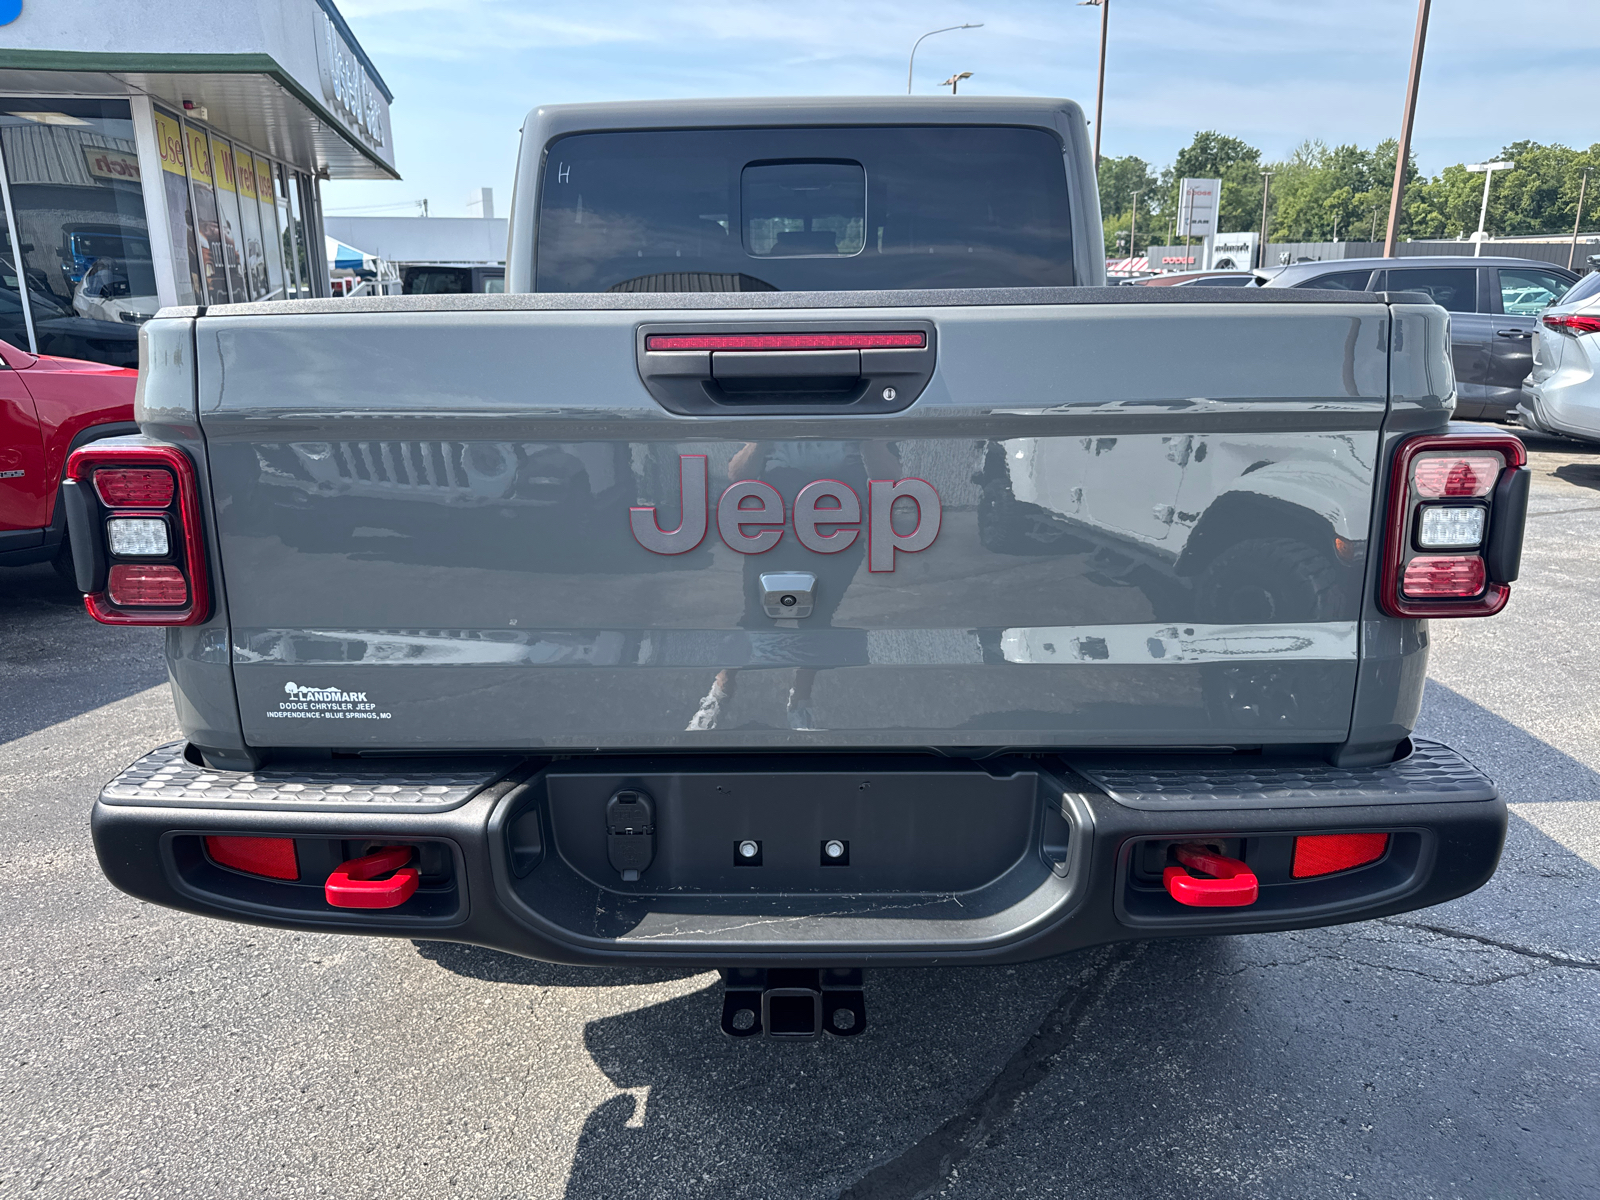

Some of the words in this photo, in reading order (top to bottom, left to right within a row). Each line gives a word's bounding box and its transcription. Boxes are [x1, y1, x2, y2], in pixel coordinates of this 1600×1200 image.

[195, 136, 217, 177] Ca
[221, 148, 273, 199] Wrehuse
[558, 161, 571, 184] H
[1162, 256, 1195, 264] DODGE
[629, 454, 943, 573] Jeep
[299, 692, 368, 702] LANDMARK
[279, 702, 309, 710] DODGE
[310, 702, 353, 710] CHRYSLER
[325, 711, 344, 719] BLUE
